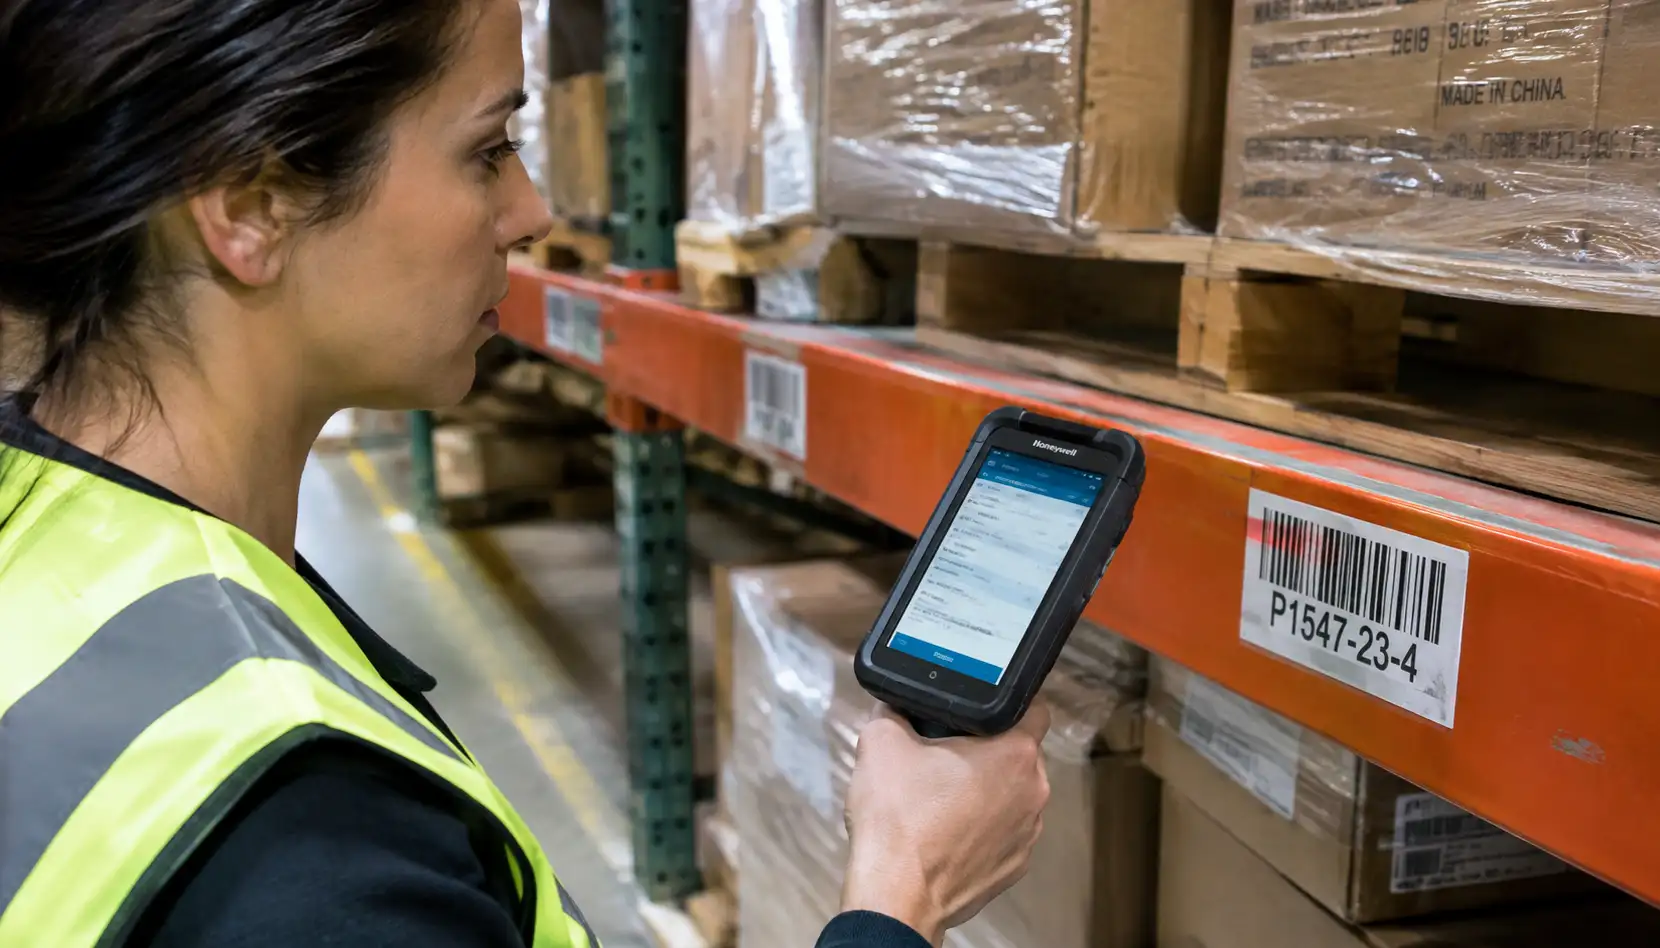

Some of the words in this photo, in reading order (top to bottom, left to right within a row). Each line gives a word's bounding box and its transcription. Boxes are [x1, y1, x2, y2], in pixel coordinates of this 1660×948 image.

[1440, 83, 1484, 106] MADE
[1489, 80, 1507, 104] IN
[1032, 439, 1078, 456] Honeywell
[1270, 590, 1418, 683] P1547-23-4
